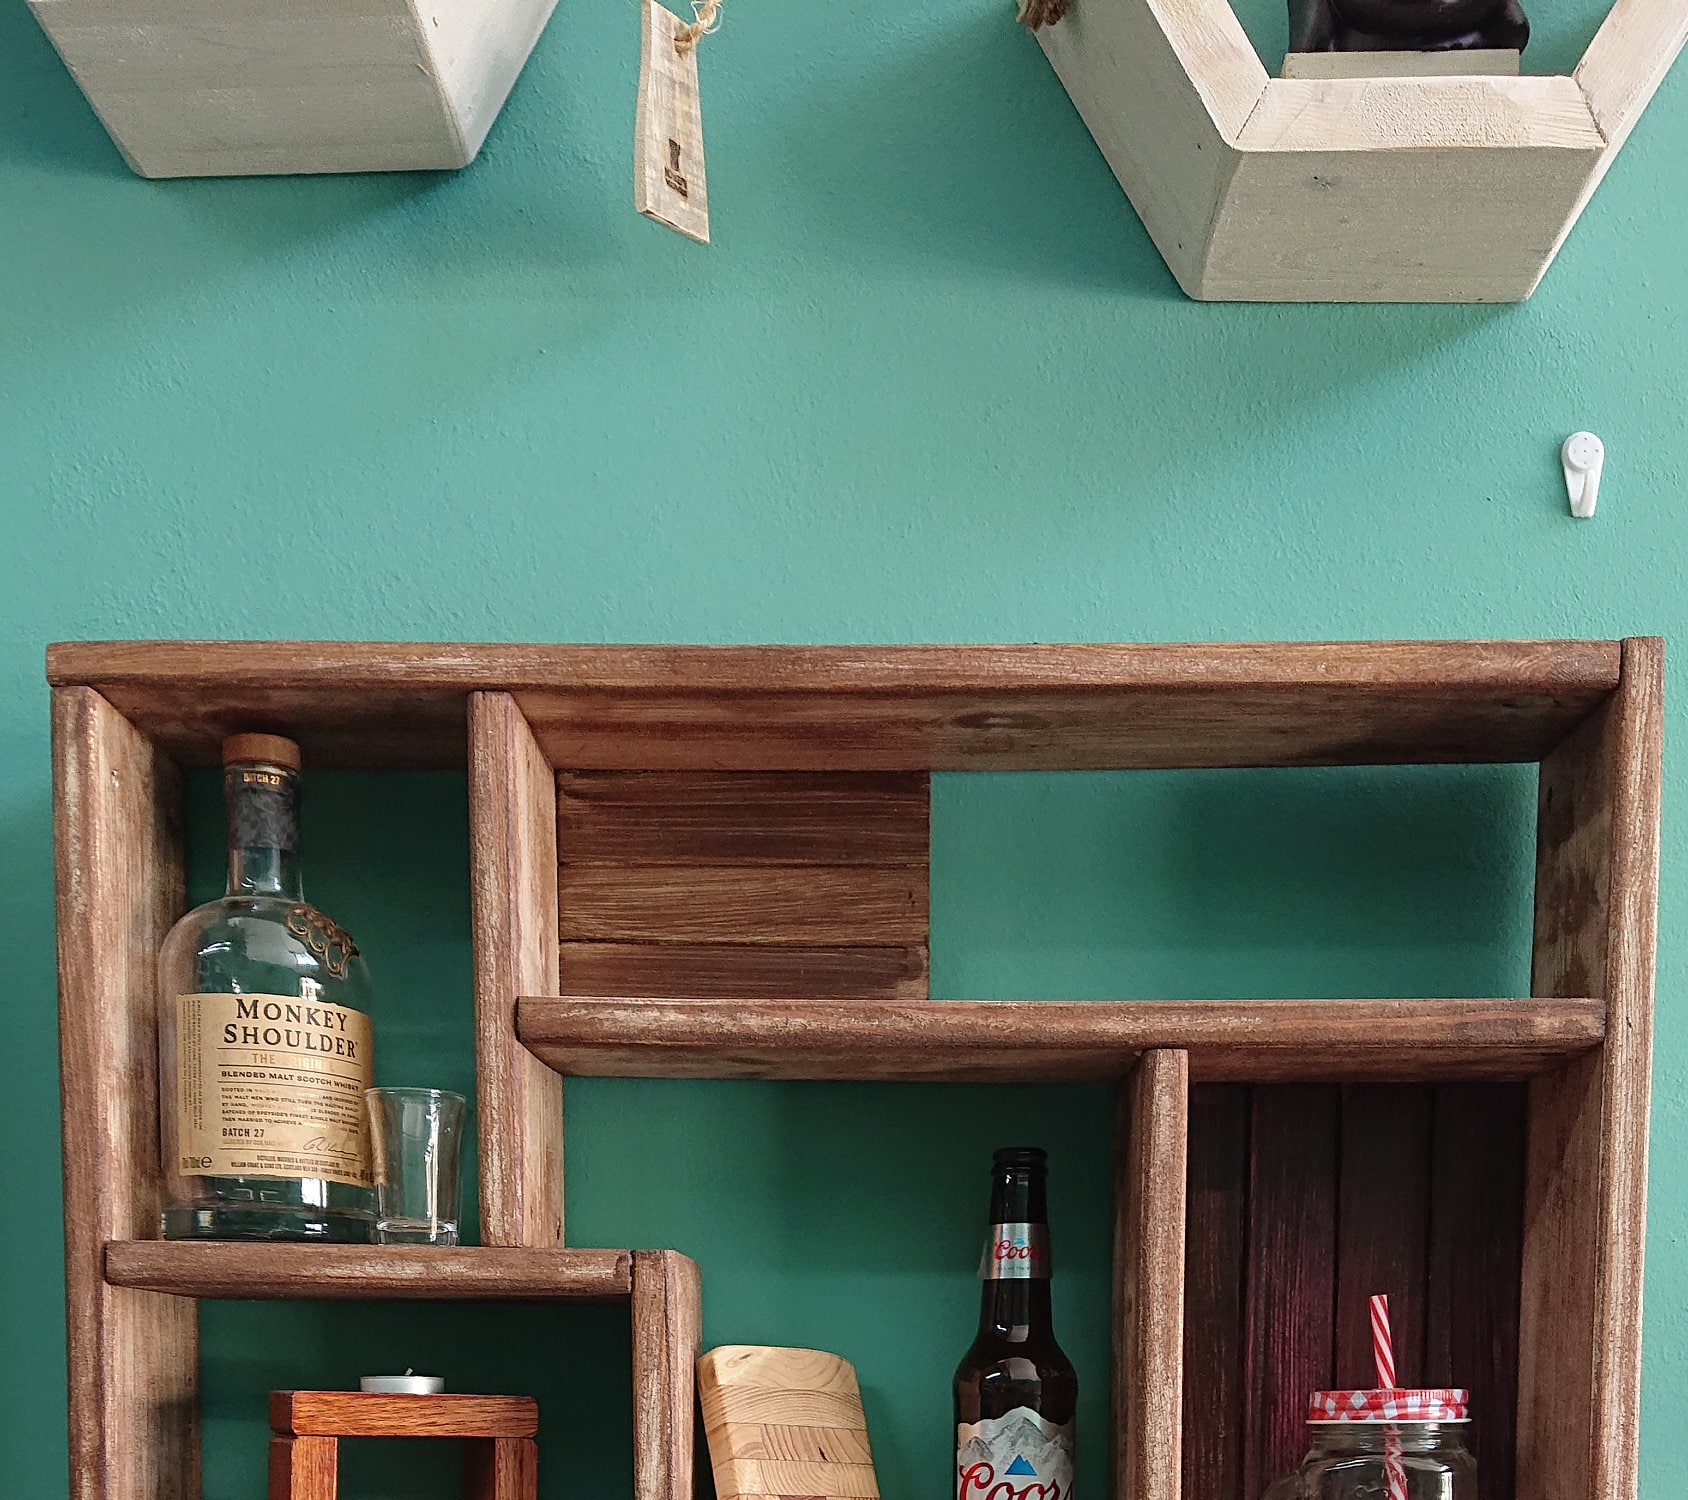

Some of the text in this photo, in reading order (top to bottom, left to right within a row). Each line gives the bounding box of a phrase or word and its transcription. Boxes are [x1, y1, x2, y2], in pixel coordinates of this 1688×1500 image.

[270, 775, 280, 785] 27
[235, 998, 348, 1031] MONKEY
[223, 1023, 356, 1058] SHOULDER
[251, 1053, 335, 1072] THE RIGINL
[221, 1071, 266, 1079] BLENDED
[268, 1073, 295, 1081] MALT
[296, 1075, 332, 1087] SCOTCH
[222, 1127, 265, 1138] BATCH 27
[994, 1239, 1038, 1260] Coor
